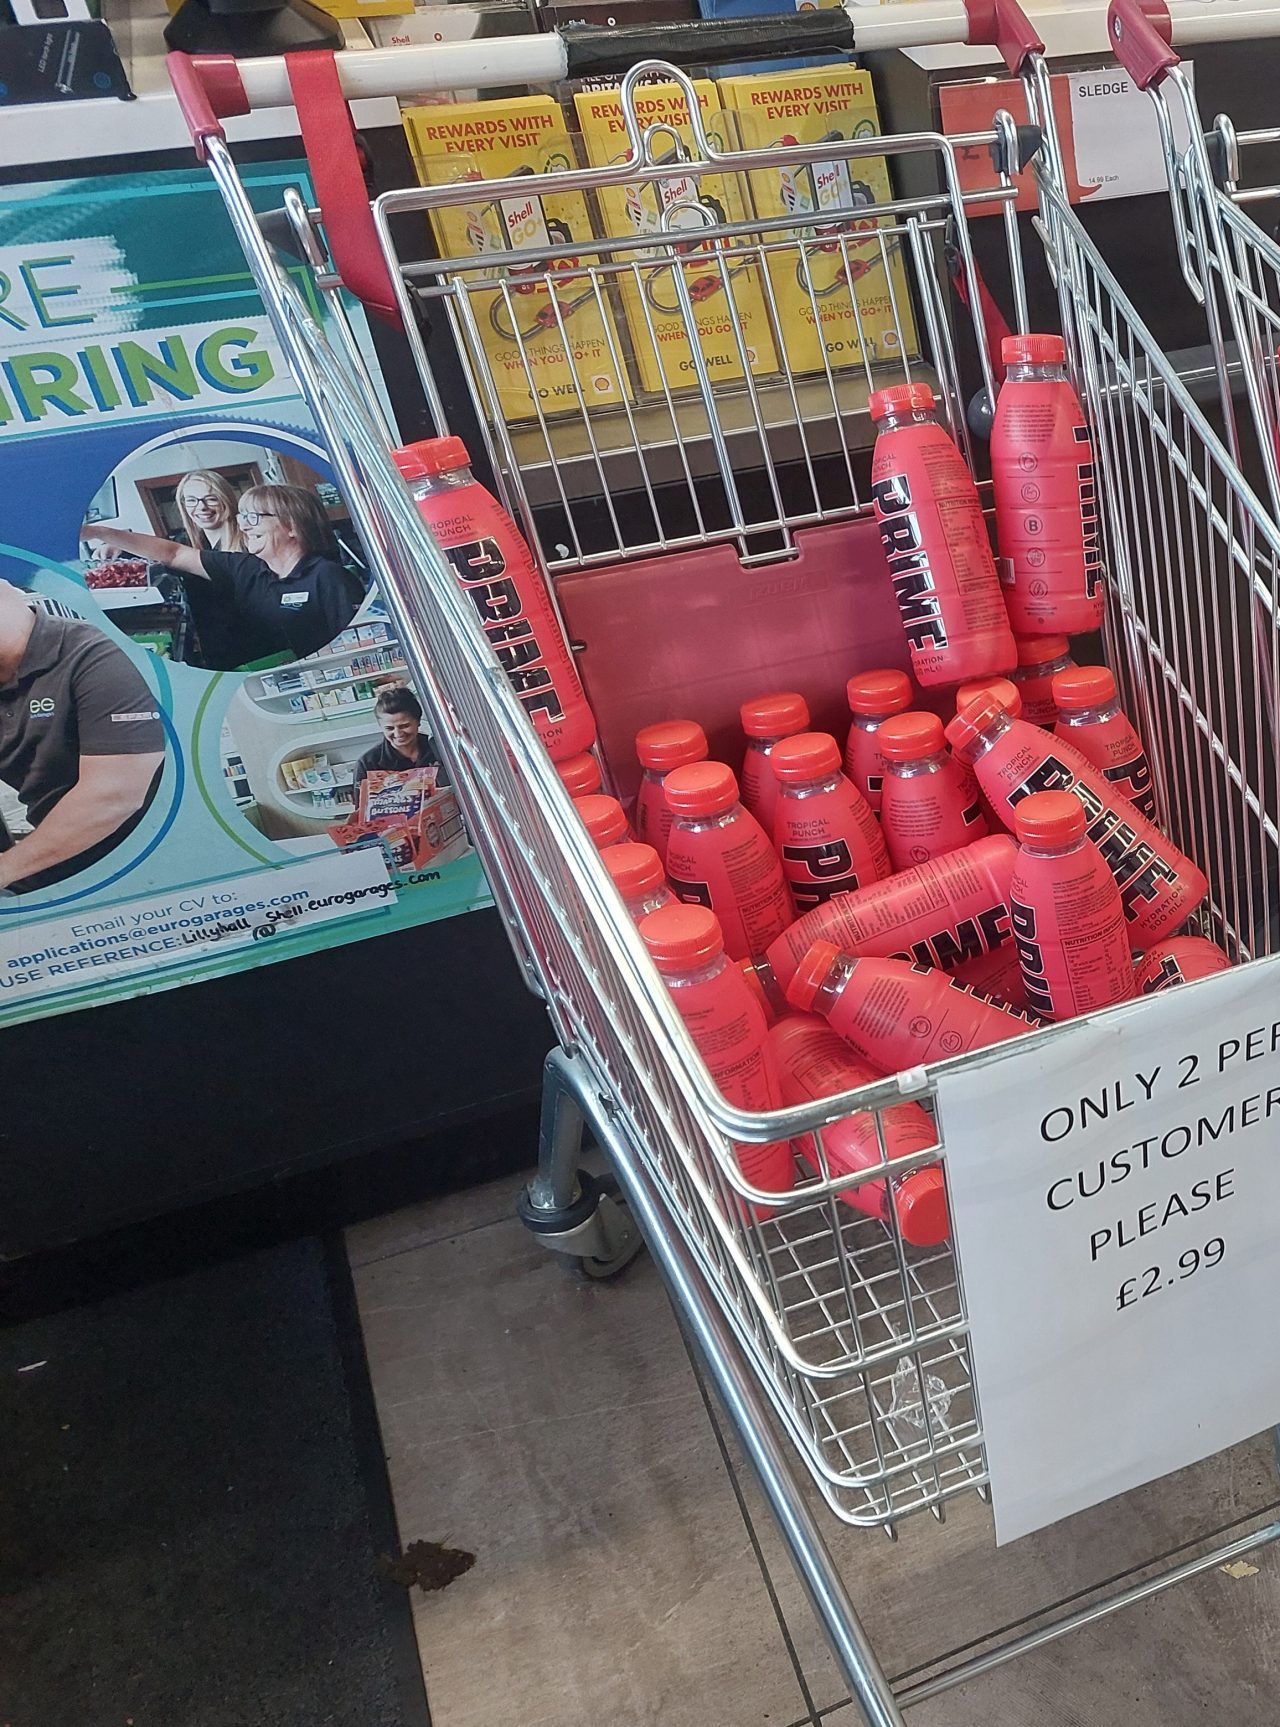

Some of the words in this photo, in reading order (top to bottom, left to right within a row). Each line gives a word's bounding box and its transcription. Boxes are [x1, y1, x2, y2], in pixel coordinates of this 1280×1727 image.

[392, 35, 411, 44] Shell
[752, 87, 822, 106] REWARDS
[823, 82, 864, 98] WITH
[1078, 81, 1129, 98] SLEDGE
[767, 102, 810, 120] EVERY
[814, 99, 851, 117] VISIT
[426, 119, 508, 141] REWARDS
[509, 114, 554, 131] WITH
[608, 116, 654, 134] EVRY
[445, 137, 495, 154] EVERY
[498, 132, 541, 149] VISIT
[817, 164, 840, 189] Shell
[664, 179, 688, 204] Shell
[507, 201, 533, 228] Shell
[540, 353, 565, 366] YOU
[826, 341, 844, 353] GO
[0, 326, 276, 427] RING
[1029, 519, 1039, 532] B
[871, 473, 948, 651] PRIME
[997, 745, 1032, 778] TROPICAL
[1006, 753, 1035, 781] PUNCH
[786, 818, 830, 830] TROPICAL
[792, 826, 826, 838] PUNCH
[71, 915, 126, 938] Email
[130, 905, 173, 926] your
[179, 896, 206, 912] CV
[211, 891, 238, 905] to:
[1139, 885, 1184, 930] HYDRATION
[7, 889, 310, 968] applications@eurogarages.com
[1149, 914, 1168, 932] 500
[1064, 931, 1103, 946] NUTRITION
[0, 969, 44, 988] USE
[49, 937, 183, 976] REFERENCE:
[1040, 1066, 1161, 1142] ONLY
[1177, 1055, 1200, 1089] 2
[1090, 1168, 1237, 1262] PLEASE
[1115, 1236, 1227, 1312] £2.99
